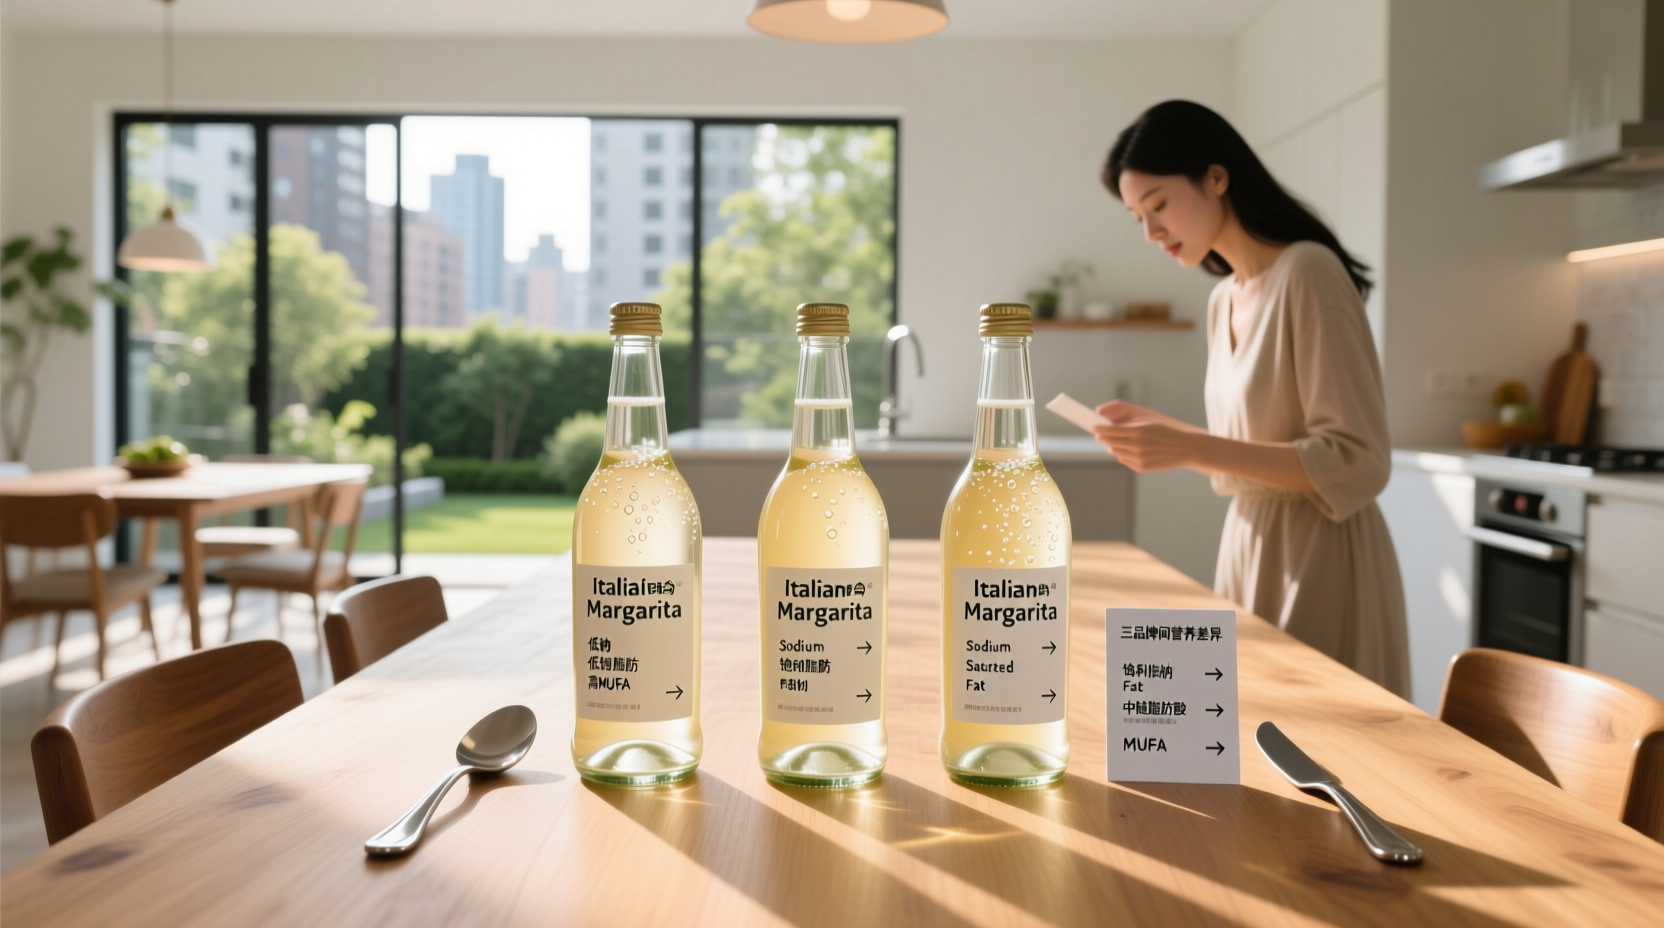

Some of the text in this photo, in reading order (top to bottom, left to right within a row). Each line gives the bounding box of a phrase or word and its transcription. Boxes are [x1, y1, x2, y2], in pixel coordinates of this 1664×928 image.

[587, 599, 682, 626] Margarita
[778, 601, 873, 627] Margarita
[964, 601, 1058, 627] Margarita
[779, 639, 825, 653] Sodium
[966, 639, 1011, 653] Sodium
[966, 679, 986, 692] Fat
[1123, 680, 1144, 692] Fat
[1123, 737, 1168, 752] MUFA
